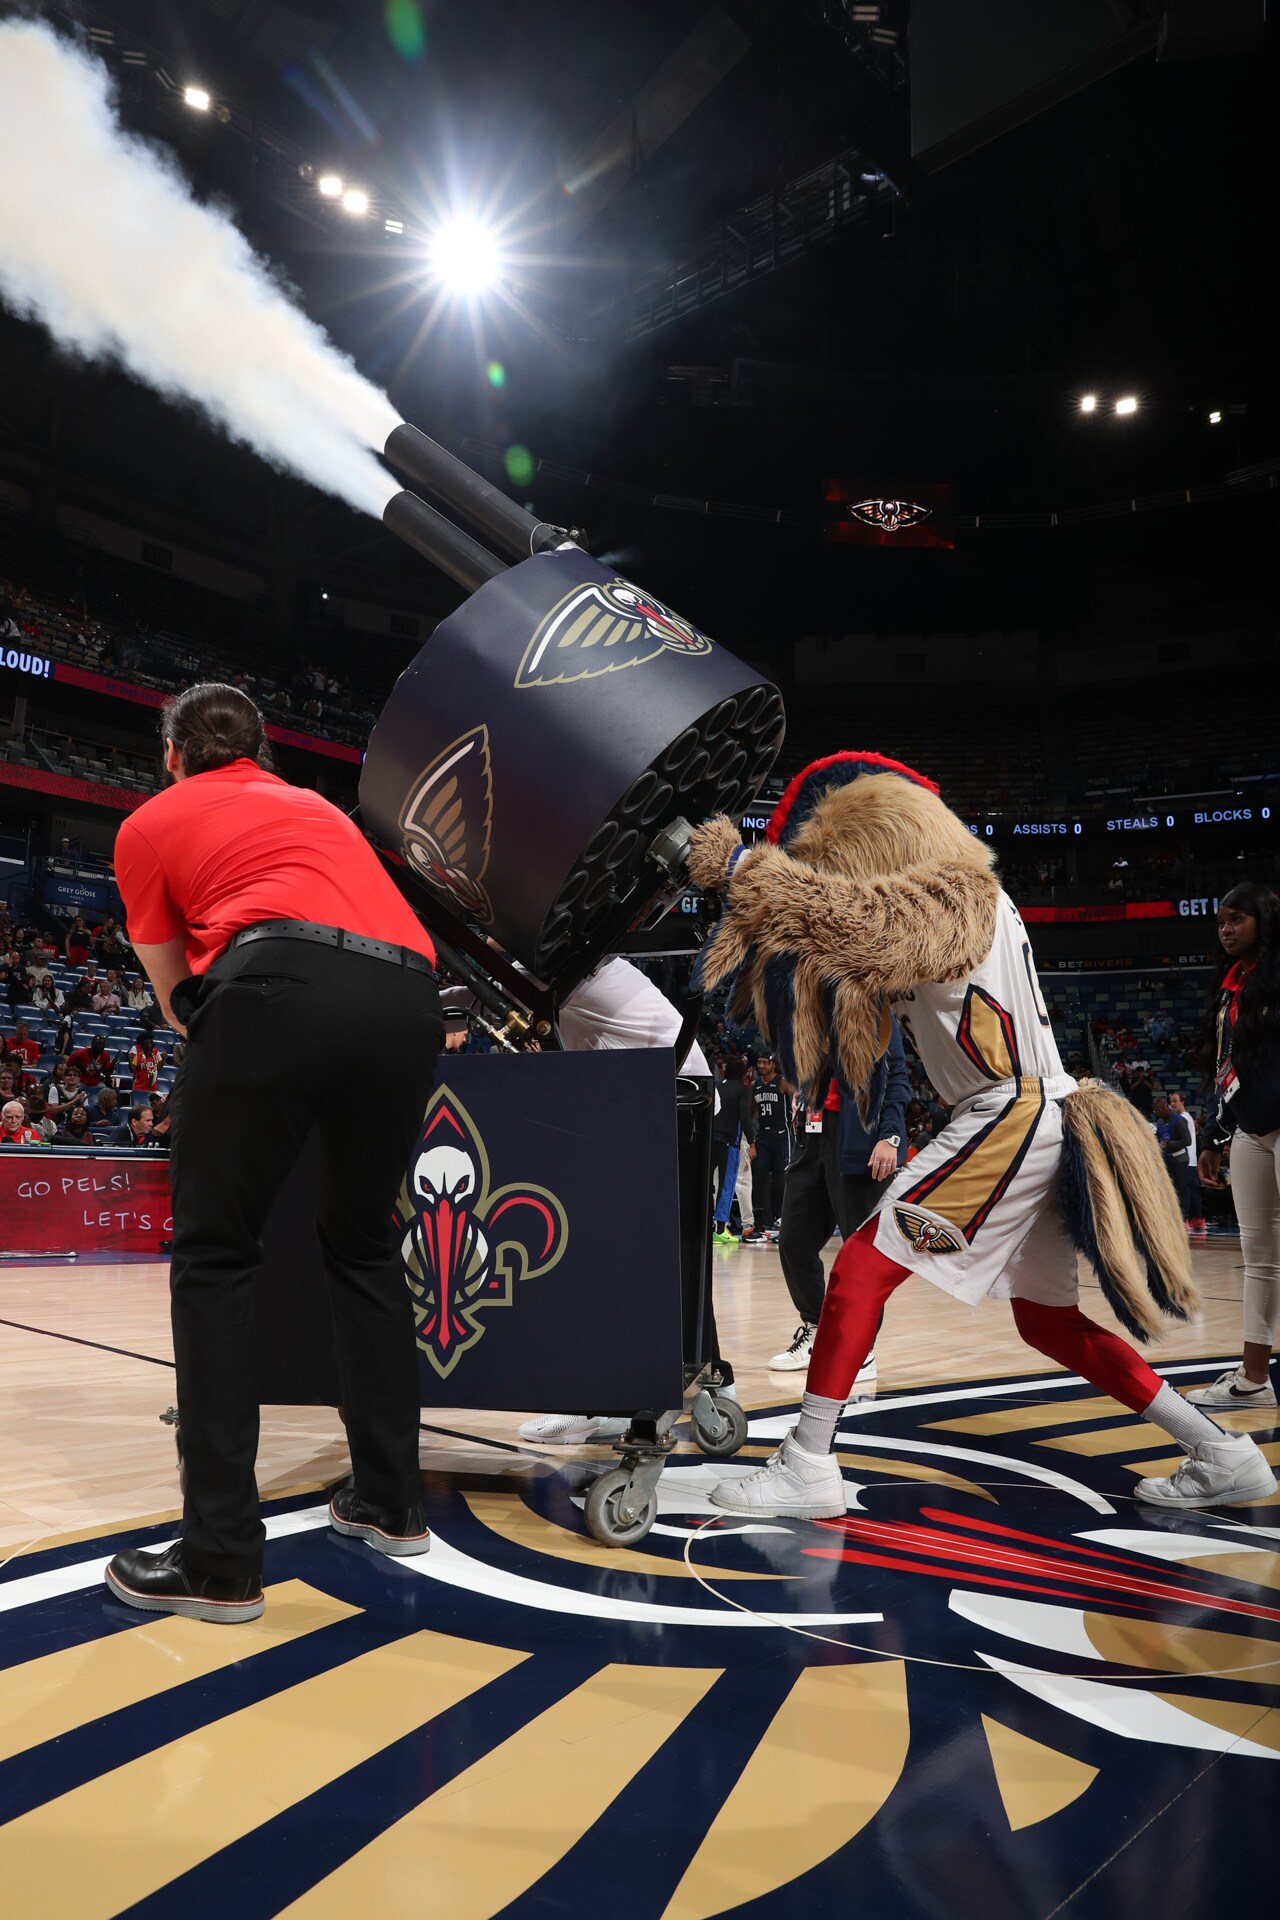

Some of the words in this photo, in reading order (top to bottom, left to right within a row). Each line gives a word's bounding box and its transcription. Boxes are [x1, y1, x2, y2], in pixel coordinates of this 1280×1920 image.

[0, 646, 50, 678] LOUD!
[1106, 816, 1159, 831] STEALS
[1166, 815, 1175, 828] 0
[1194, 808, 1252, 825] BLOCKS
[1261, 807, 1271, 820] 0
[1012, 823, 1067, 835] ASSISTS
[1073, 823, 1082, 835] 0
[57, 886, 74, 894] GREY
[74, 888, 96, 898] GOOSE
[681, 896, 705, 913] GE
[1179, 898, 1209, 916] GET
[1058, 958, 1133, 969] BETRIVERS
[760, 1103, 772, 1116] 34
[17, 1181, 51, 1199] GO
[61, 1173, 131, 1195] PELS!
[84, 1210, 152, 1230] LET'S
